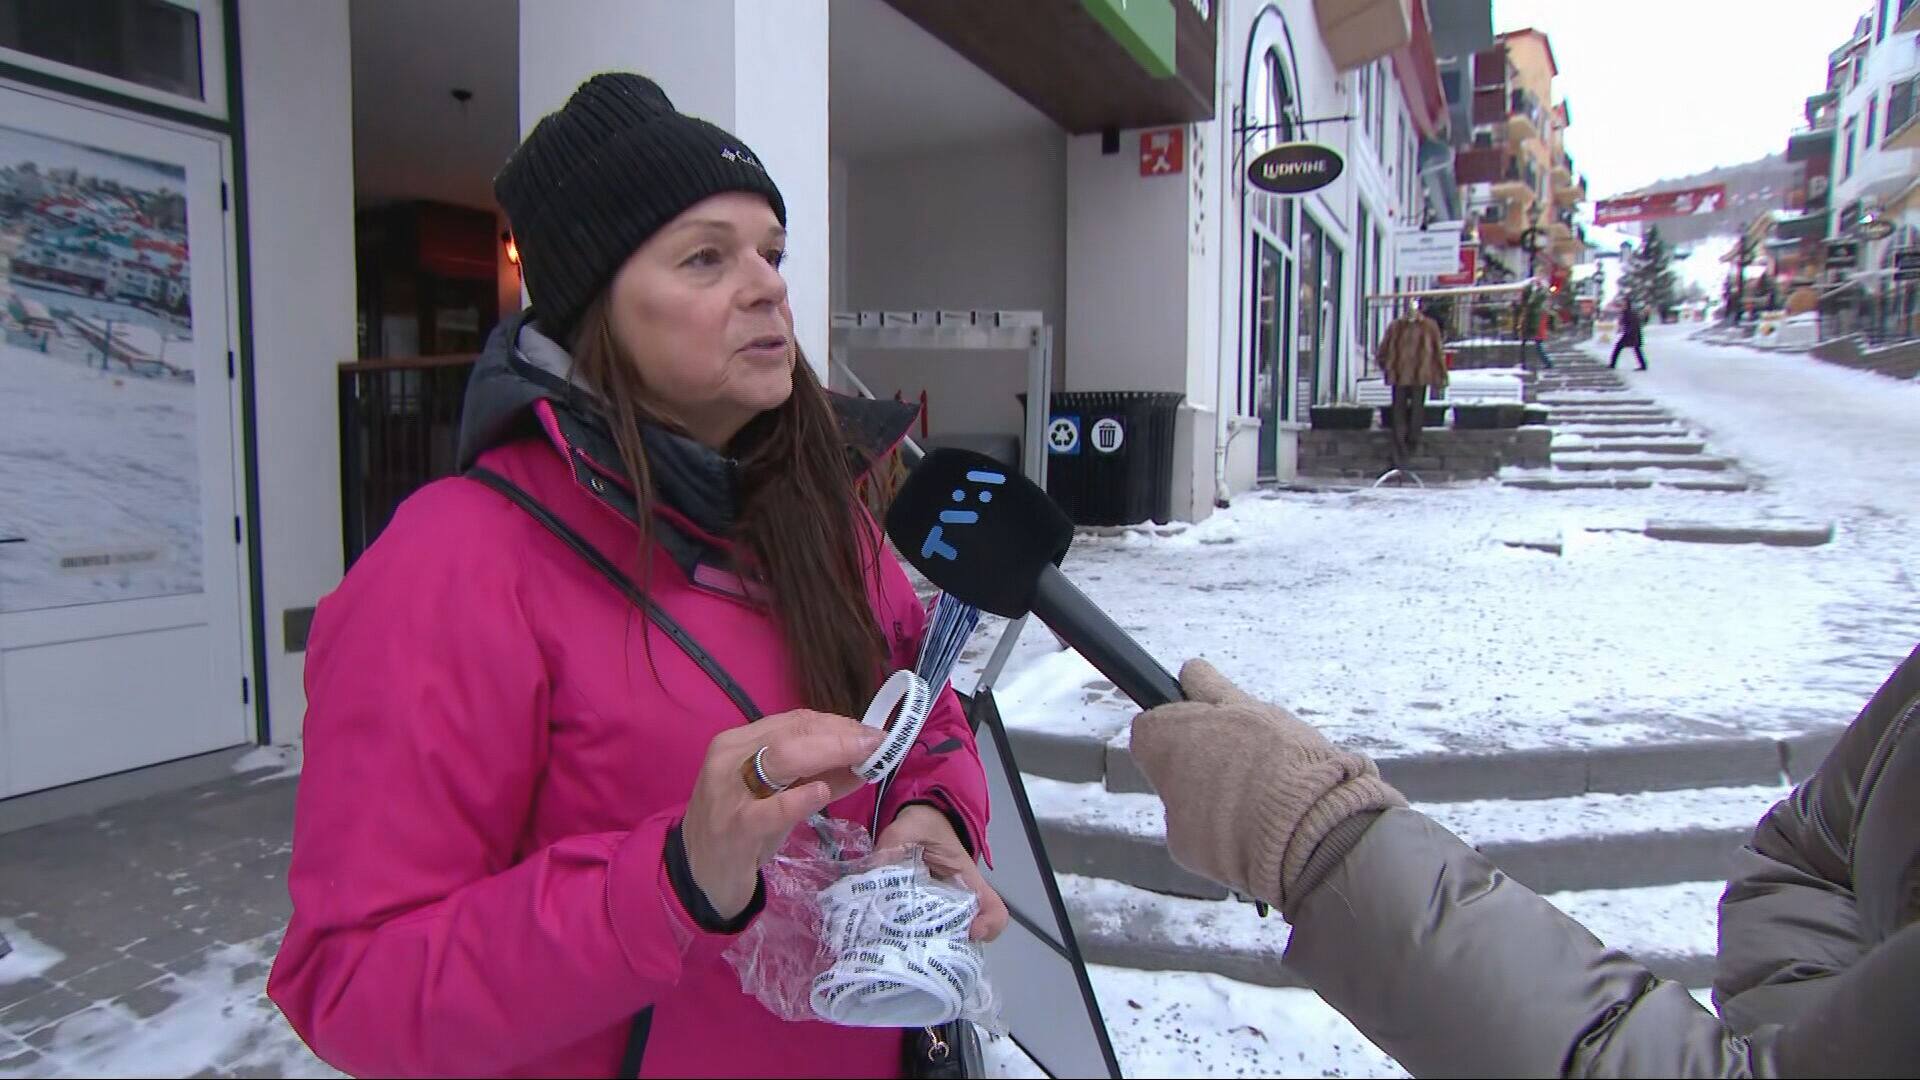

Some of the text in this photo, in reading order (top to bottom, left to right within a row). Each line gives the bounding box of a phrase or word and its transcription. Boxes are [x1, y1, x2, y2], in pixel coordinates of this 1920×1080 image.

[881, 714, 919, 764] MISSING
[851, 880, 877, 895] FIND
[859, 952, 885, 966] FIND
